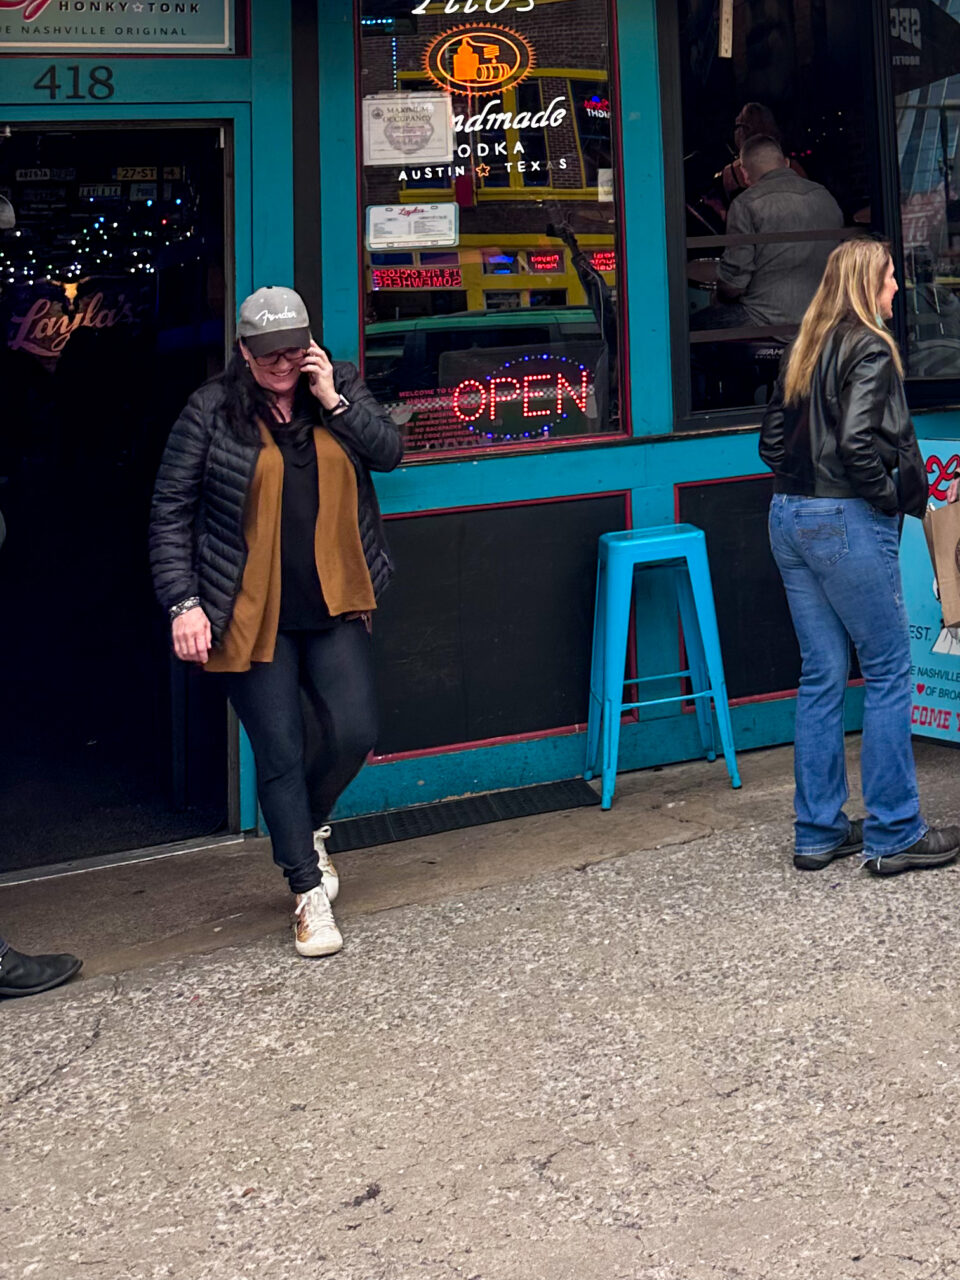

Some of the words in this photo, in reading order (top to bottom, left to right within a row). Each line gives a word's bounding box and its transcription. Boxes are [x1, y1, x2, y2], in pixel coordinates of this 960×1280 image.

[59, 0, 129, 14] HONKY
[148, 1, 200, 15] TONK
[21, 25, 106, 36] NASHVILLE
[114, 26, 187, 37] ORIGINAL
[33, 64, 115, 100] 418
[451, 96, 566, 133] ndmade
[457, 141, 526, 157] ODKA
[398, 165, 465, 181] AUSTIN
[8, 292, 142, 357] Layla's
[255, 306, 297, 327] Fender
[452, 370, 588, 421] OPEN
[909, 624, 931, 641] EST.
[917, 666, 960, 683] NASHVILLE
[925, 685, 937, 697] OF
[911, 704, 952, 730] COME
